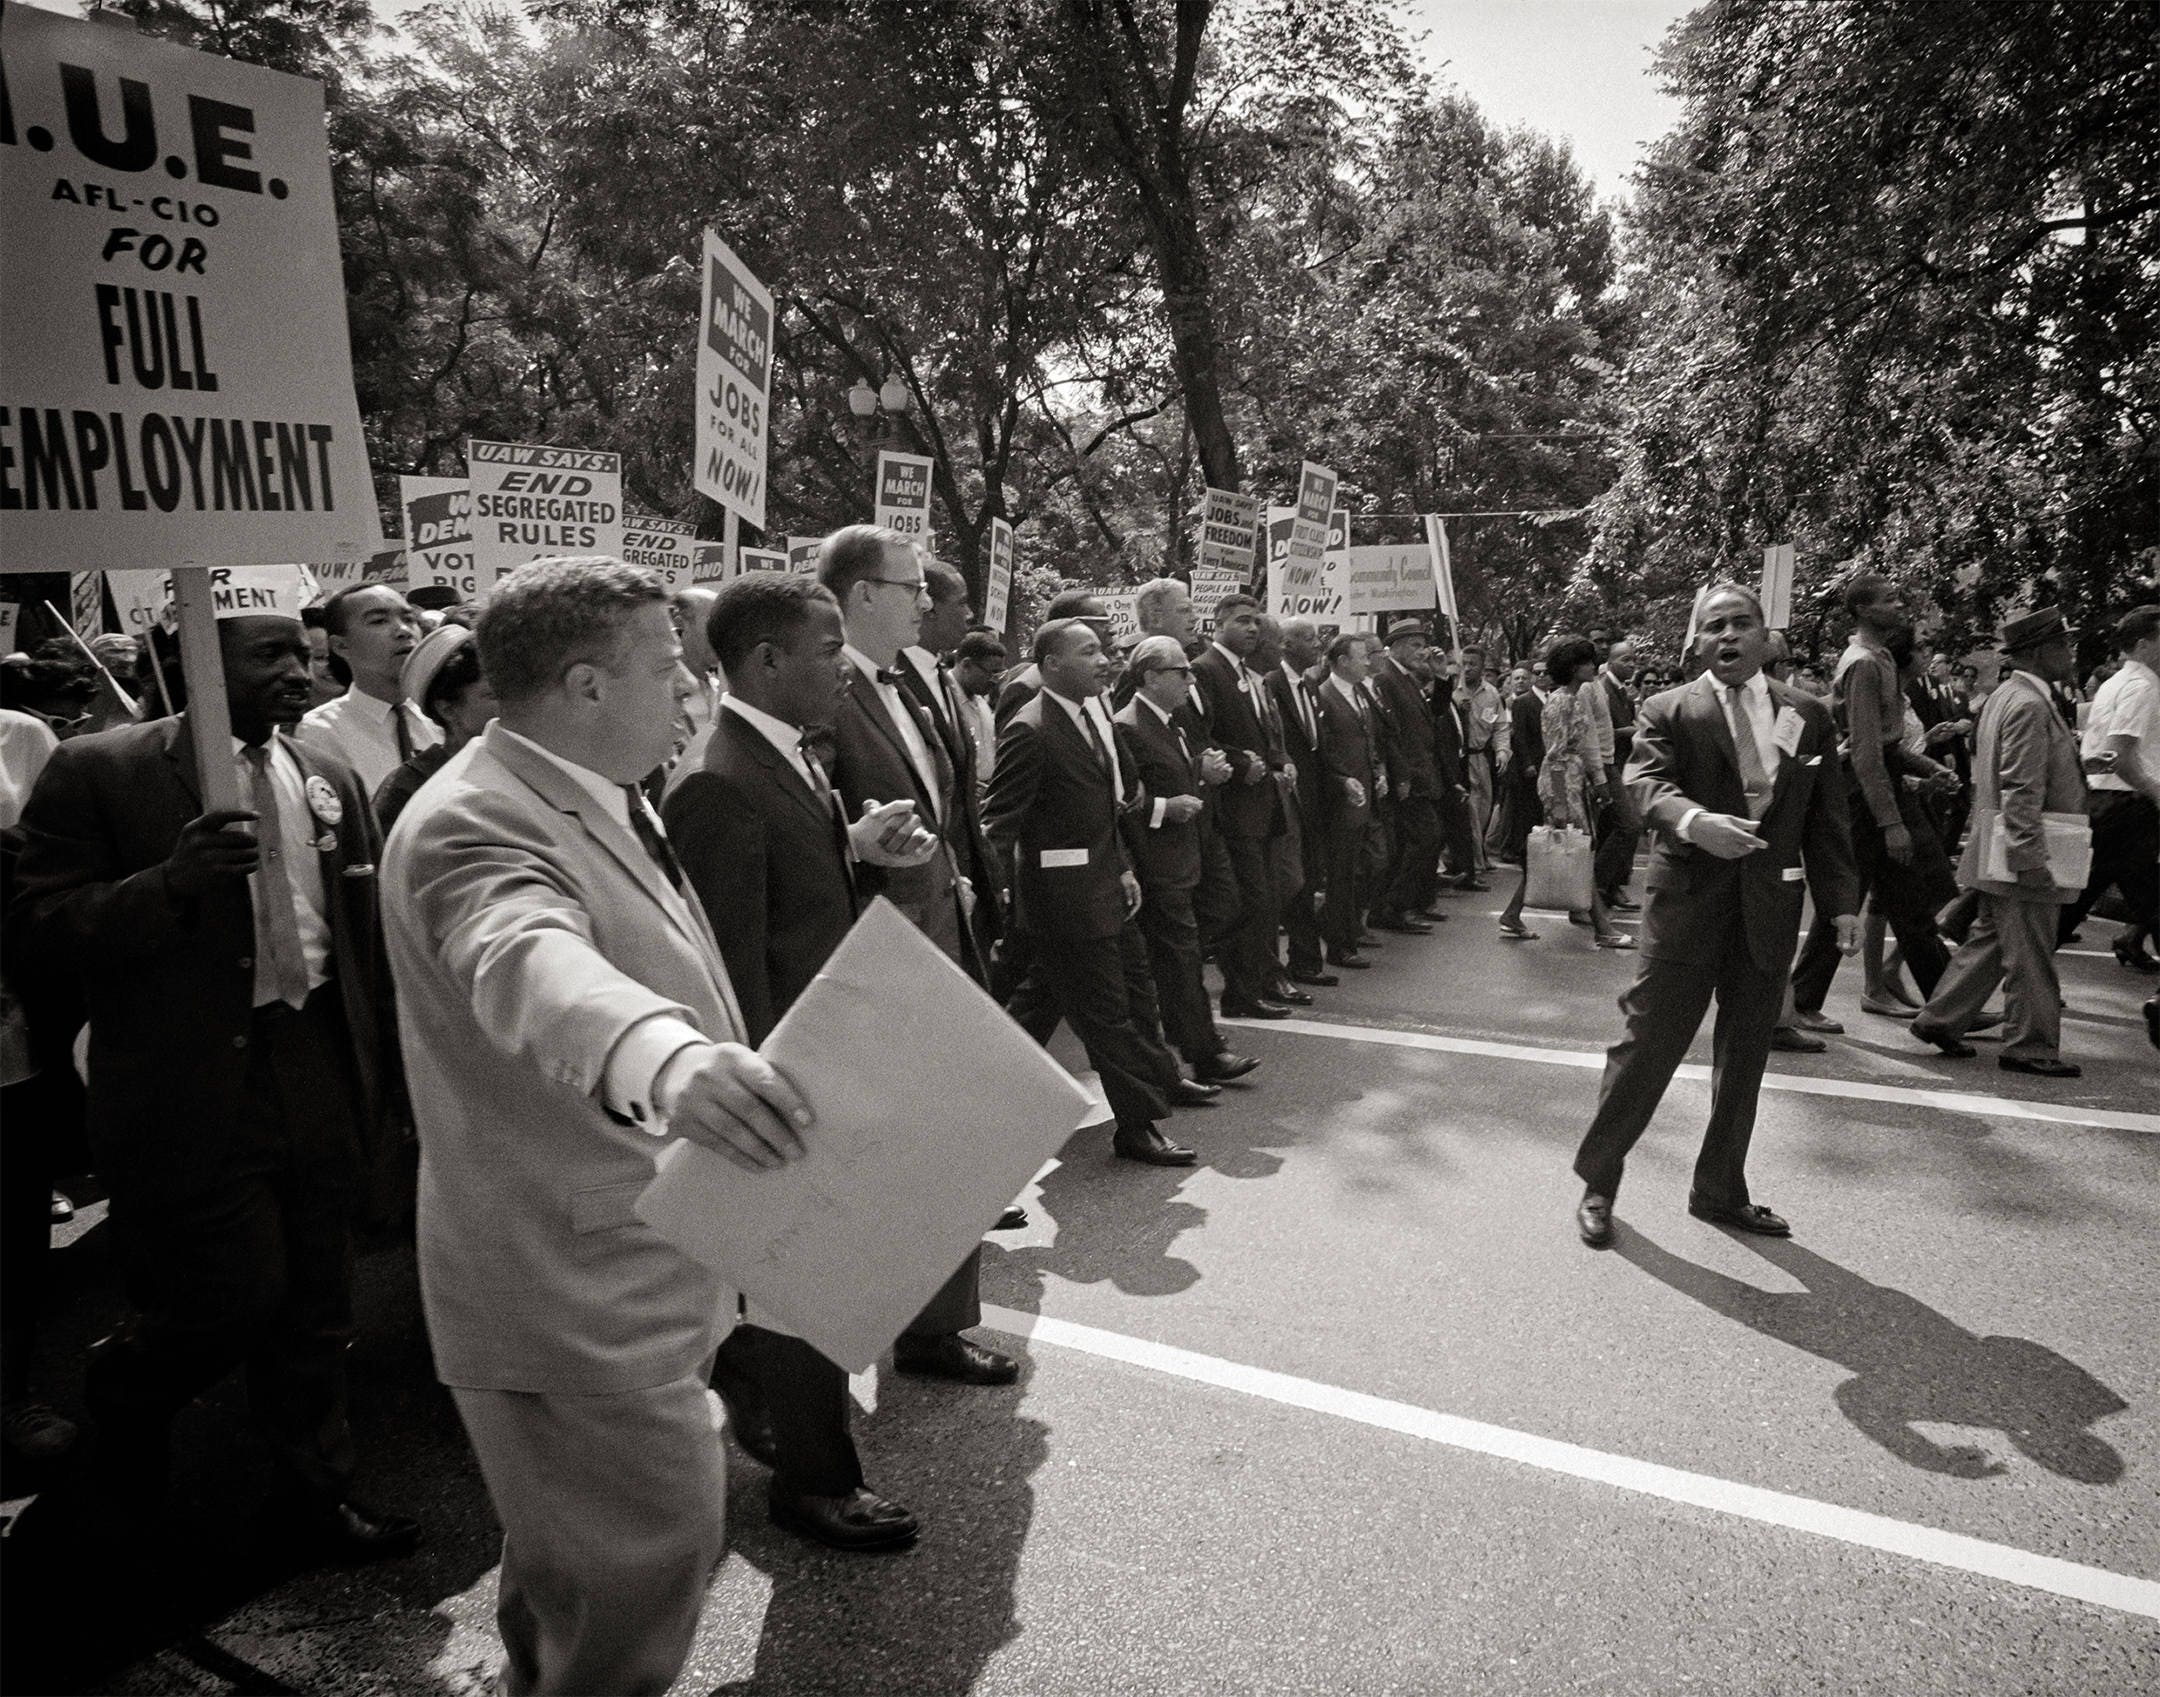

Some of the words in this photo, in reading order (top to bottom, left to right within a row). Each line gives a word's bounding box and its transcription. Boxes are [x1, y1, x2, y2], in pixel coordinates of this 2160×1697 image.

[0, 46, 289, 200] .U.E.
[51, 178, 220, 228] AFL-CIO
[102, 228, 207, 275] FOR
[733, 283, 751, 322] WE
[95, 283, 219, 392] FULL
[713, 296, 765, 369] MARCH
[729, 345, 751, 376] FOR
[709, 373, 760, 438] JOBS
[711, 413, 735, 444] FOR
[741, 437, 757, 461] ALL
[0, 405, 335, 513] EMPLOYMENT
[477, 444, 535, 464] UAW
[538, 450, 617, 472] SAYS:
[707, 447, 760, 507] NOW!
[900, 465, 915, 479] WE
[498, 470, 593, 497] END
[884, 479, 925, 497] MARCH
[477, 493, 616, 524] SEGREGATED
[498, 521, 597, 549] RULES
[622, 531, 677, 551] END
[1205, 525, 1252, 549] FREEDOM
